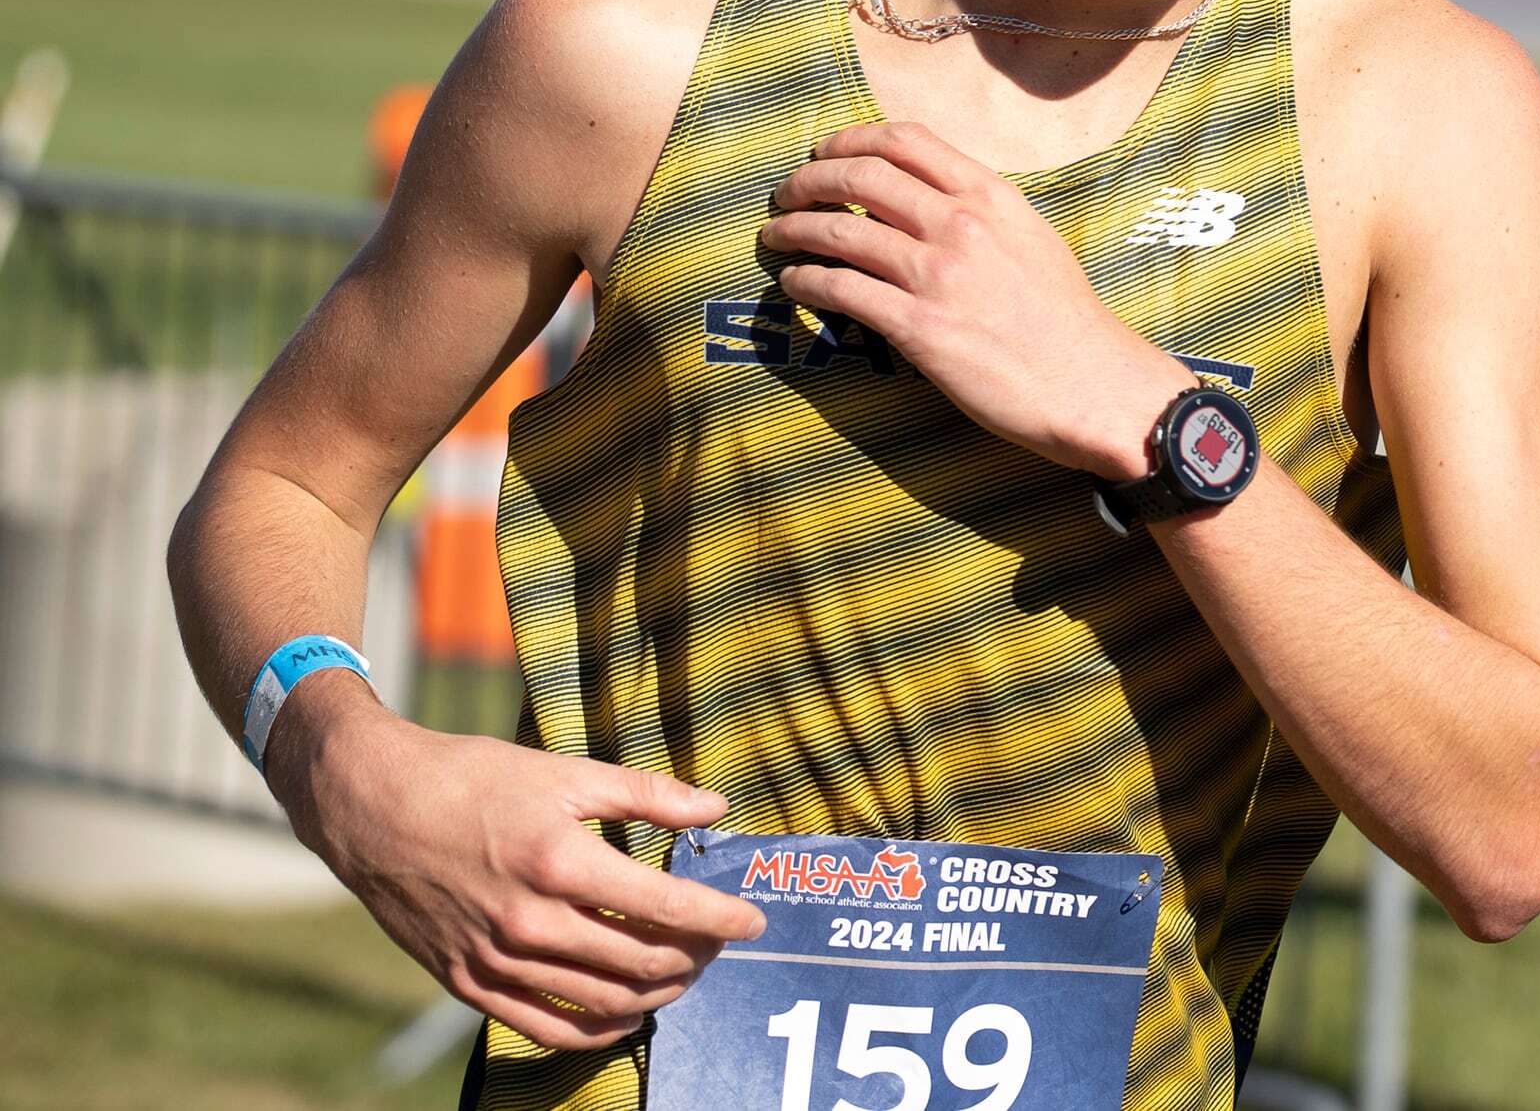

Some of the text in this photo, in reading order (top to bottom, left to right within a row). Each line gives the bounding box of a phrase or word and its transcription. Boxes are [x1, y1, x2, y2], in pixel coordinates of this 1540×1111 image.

[741, 848, 902, 901] MHSAA
[940, 856, 1059, 888] CROSS
[739, 890, 923, 911] michigan high school athletic association
[937, 886, 1099, 919] COUNTRY
[827, 917, 1006, 952] 2024 FINAL
[767, 998, 1033, 1111] 159
